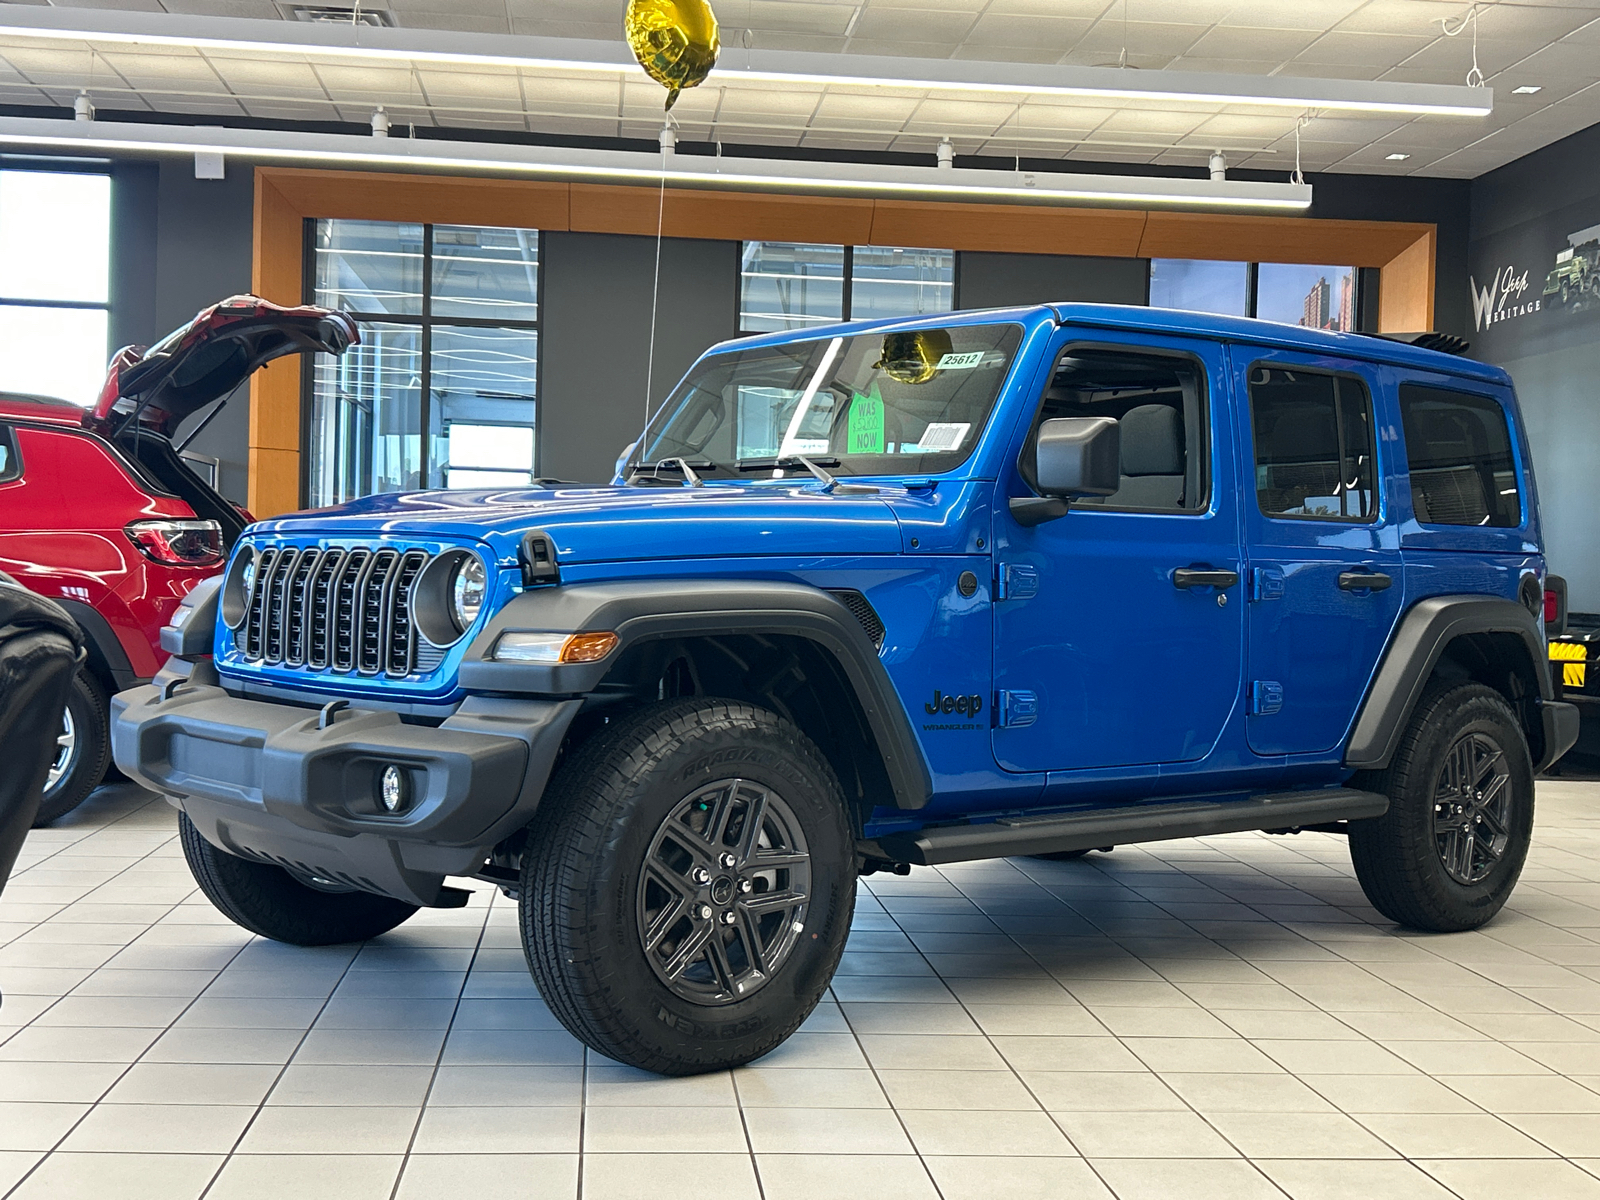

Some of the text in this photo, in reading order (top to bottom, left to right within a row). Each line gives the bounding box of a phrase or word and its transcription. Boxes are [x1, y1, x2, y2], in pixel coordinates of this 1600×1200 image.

[1498, 266, 1528, 312] Jeep
[1486, 300, 1540, 325] HERITAGE
[944, 354, 978, 365] 25612
[858, 402, 876, 417] WAS
[857, 432, 877, 448] NOW
[925, 689, 982, 718] Jeep
